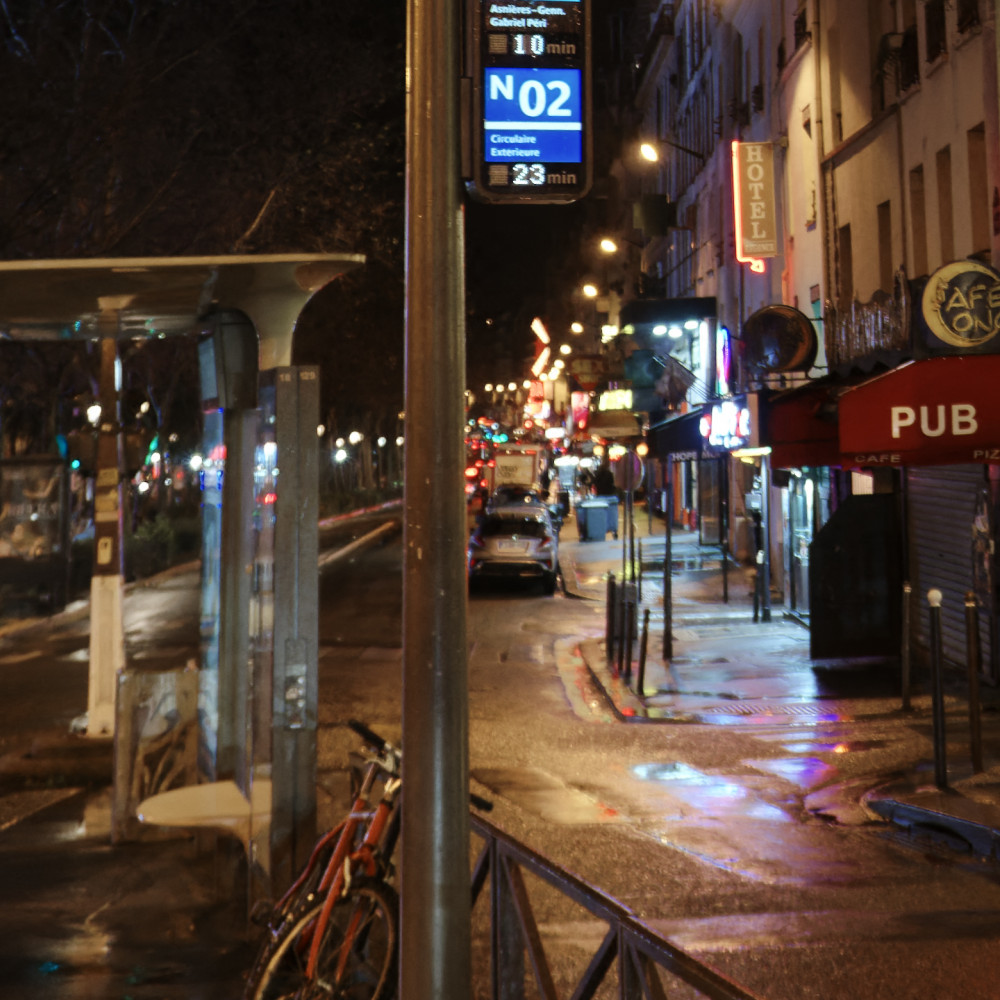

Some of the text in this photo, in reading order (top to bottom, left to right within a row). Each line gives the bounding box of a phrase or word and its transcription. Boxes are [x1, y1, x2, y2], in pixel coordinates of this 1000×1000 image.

[489, 17, 525, 27] Gabriel
[513, 34, 576, 55] 10 min
[490, 134, 537, 144] Circulaire
[512, 163, 577, 185] 23 min
[745, 145, 767, 239] HOTEL
[891, 404, 978, 438] PUB
[855, 454, 901, 463] CAFE
